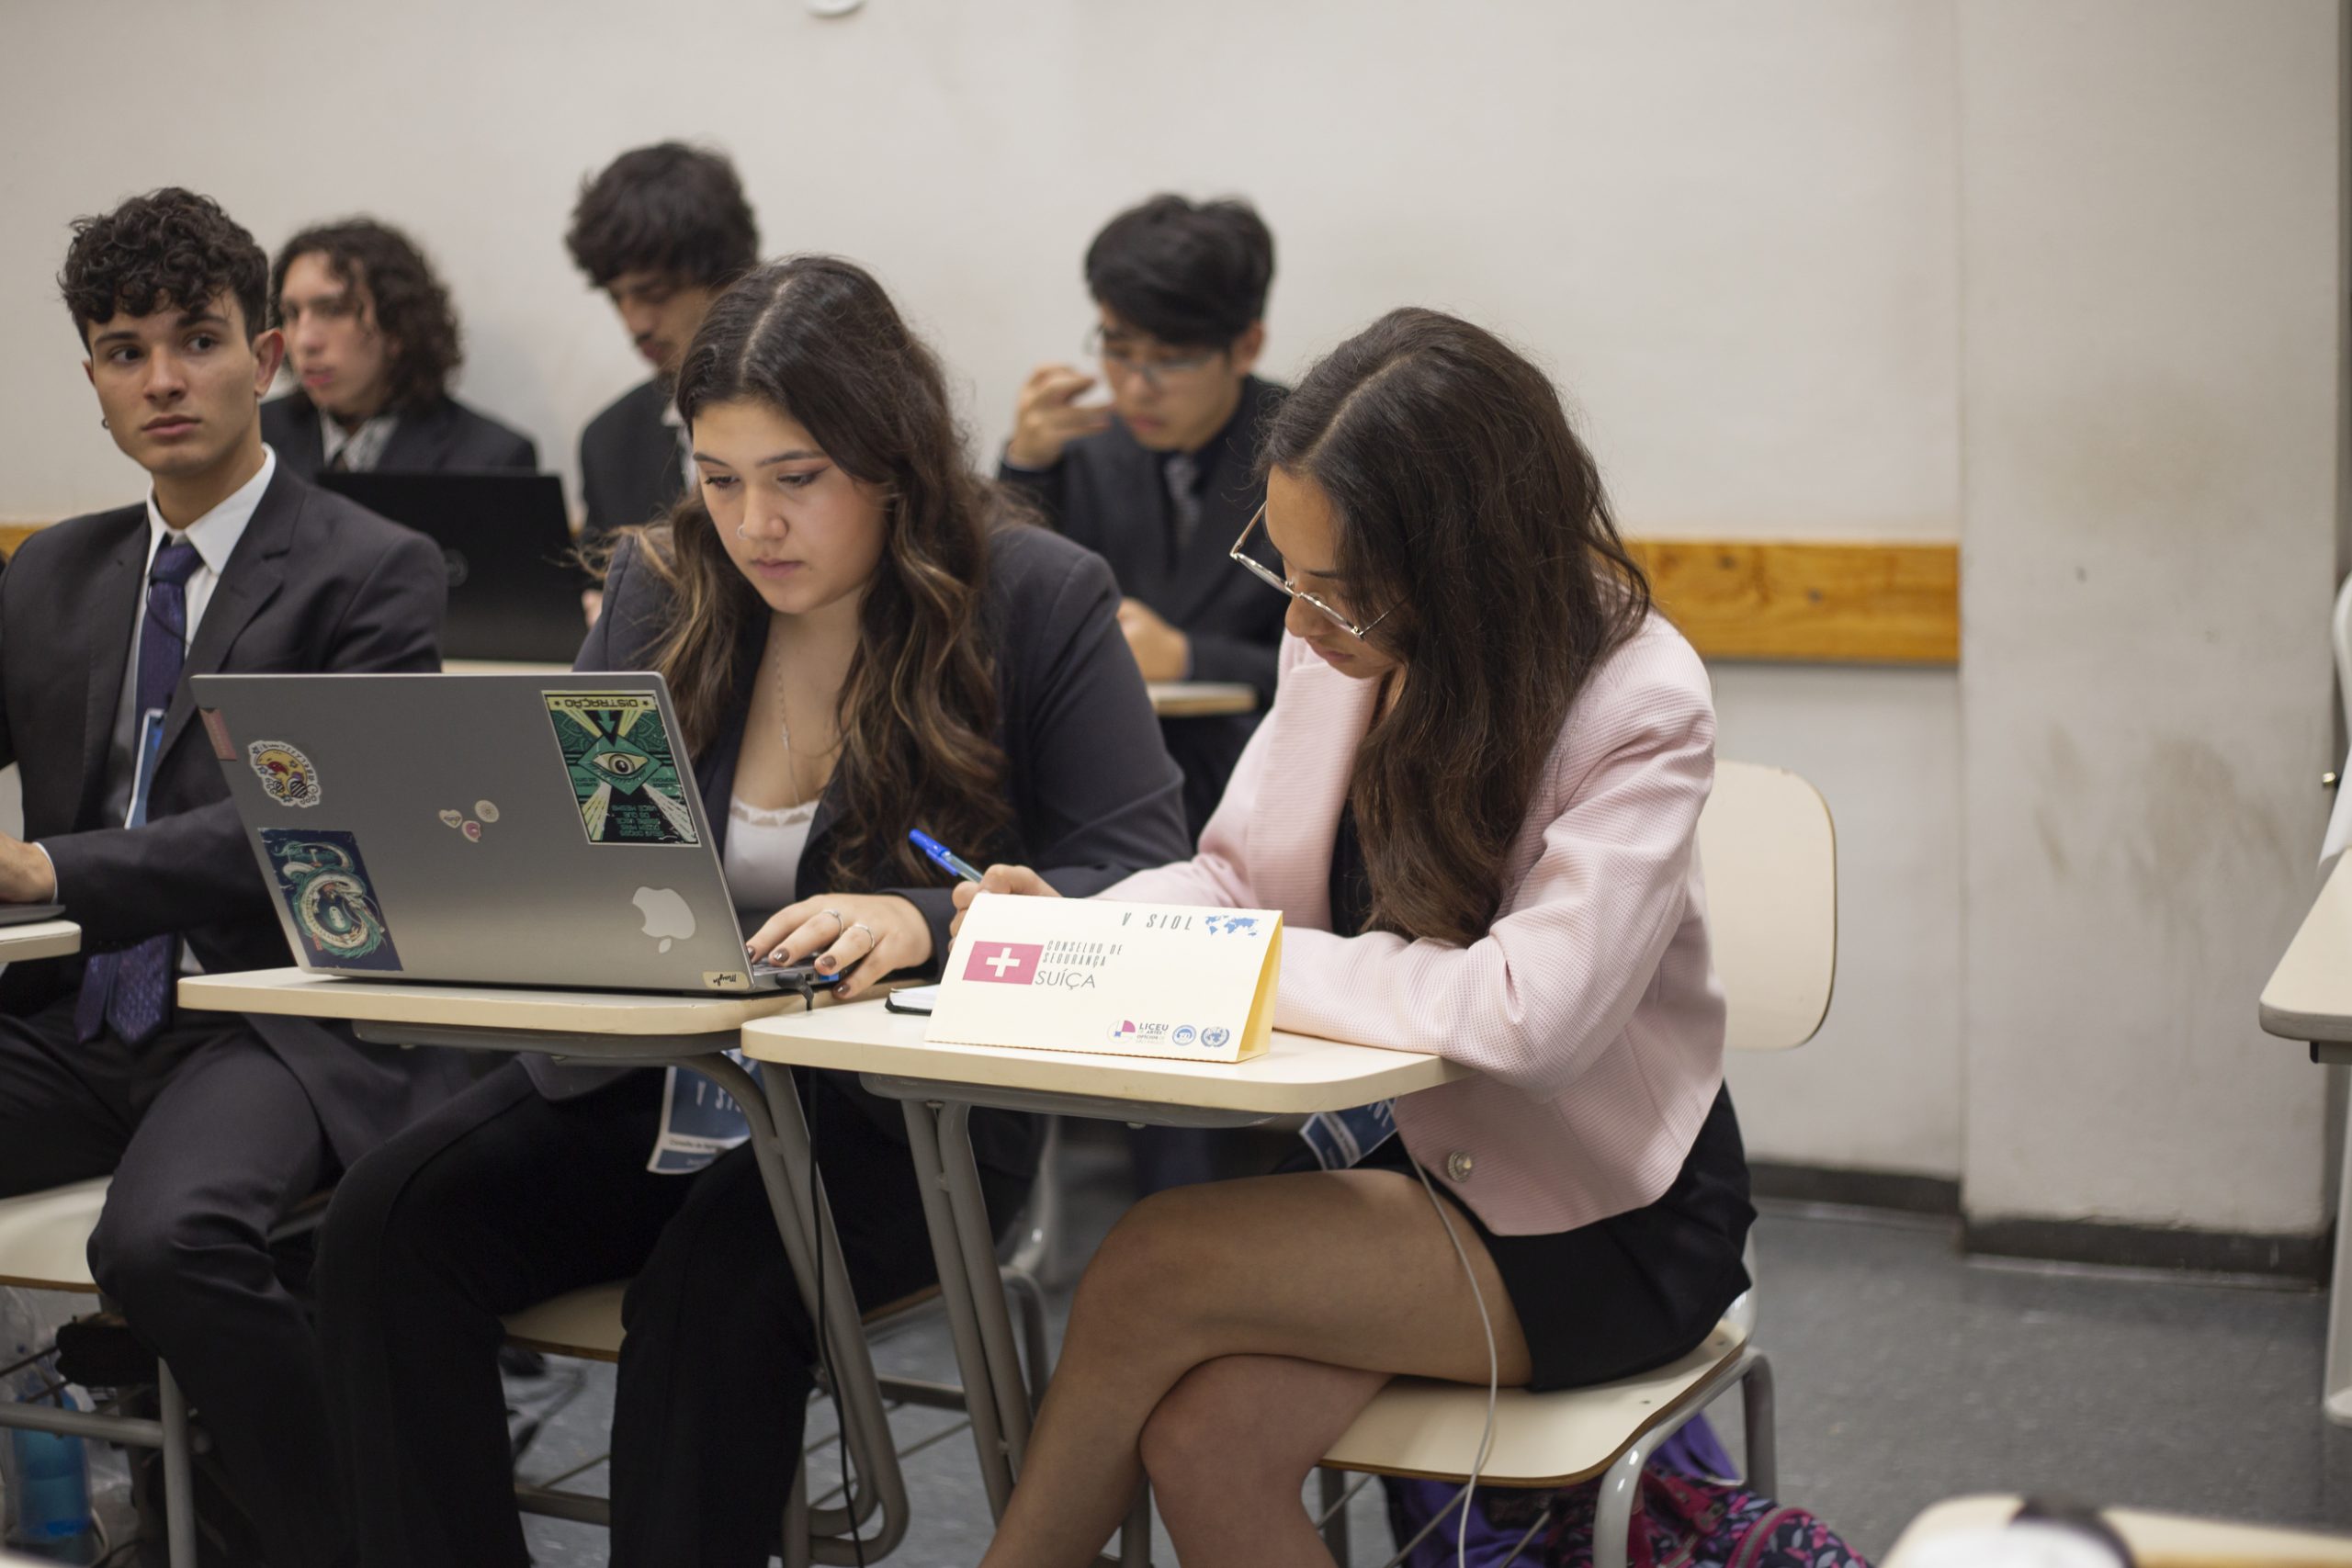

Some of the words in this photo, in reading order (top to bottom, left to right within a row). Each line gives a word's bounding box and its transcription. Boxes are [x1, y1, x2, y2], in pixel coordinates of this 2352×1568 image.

[564, 698, 639, 709] DISTRAÇÃO
[1122, 912, 1132, 926] V
[1146, 914, 1193, 931] SIOL
[1047, 940, 1103, 954] CONSELHO
[1110, 943, 1123, 955] DE
[1043, 952, 1106, 968] SEGURANÇA
[1035, 968, 1096, 990] SUÍÇA
[1139, 1022, 1169, 1032] LICEU
